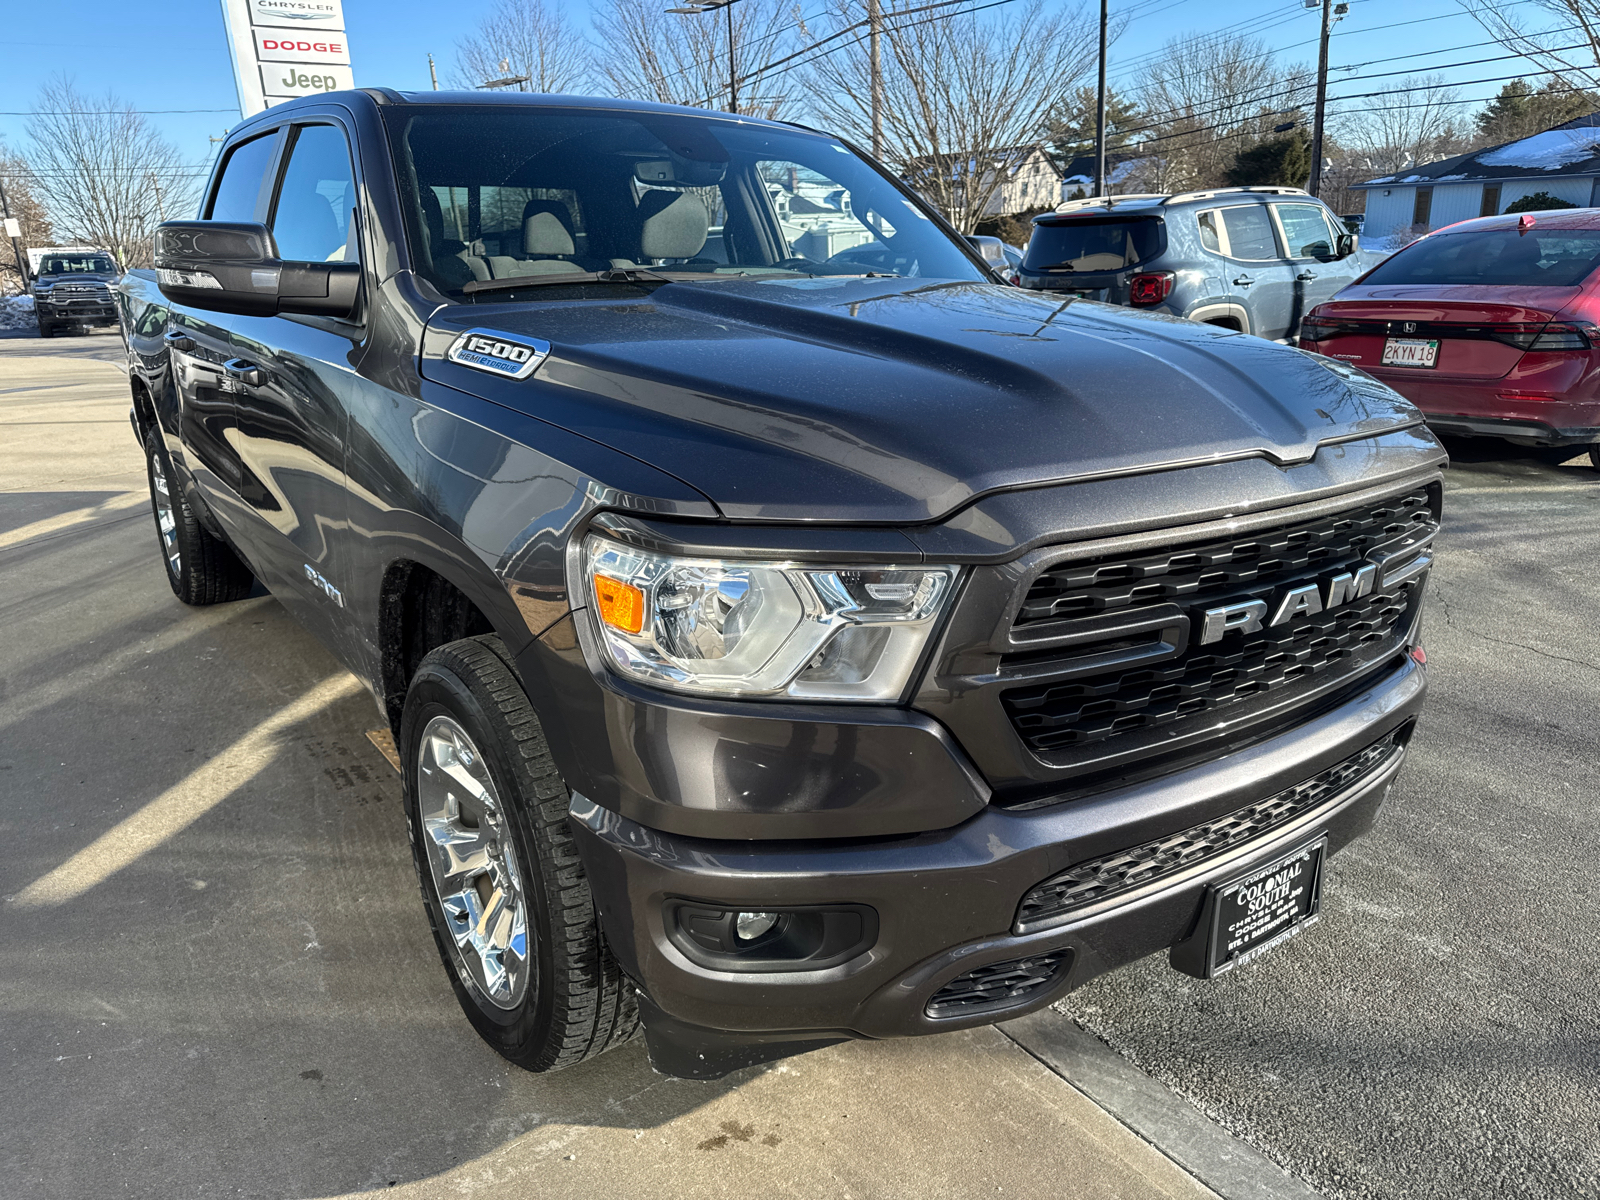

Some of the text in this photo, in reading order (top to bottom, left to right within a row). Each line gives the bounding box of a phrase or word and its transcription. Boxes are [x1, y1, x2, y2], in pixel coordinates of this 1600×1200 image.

[258, 1, 334, 12] CHRYSLER
[263, 40, 343, 53] DODGE
[282, 68, 337, 91] Jeep
[459, 351, 480, 363] HEMI
[467, 337, 532, 363] 1500
[1200, 564, 1377, 646] RAM
[1237, 861, 1302, 905] COLONIAL
[1247, 880, 1291, 915] SOUTH
[1228, 899, 1284, 932] CHRYSLER
[1228, 937, 1243, 950] RTE.
[1244, 934, 1249, 942] 6
[1290, 905, 1299, 916] MA
[1235, 899, 1296, 937] DODGE RAM
[1251, 951, 1256, 959] 6
[1291, 926, 1300, 936] MA
